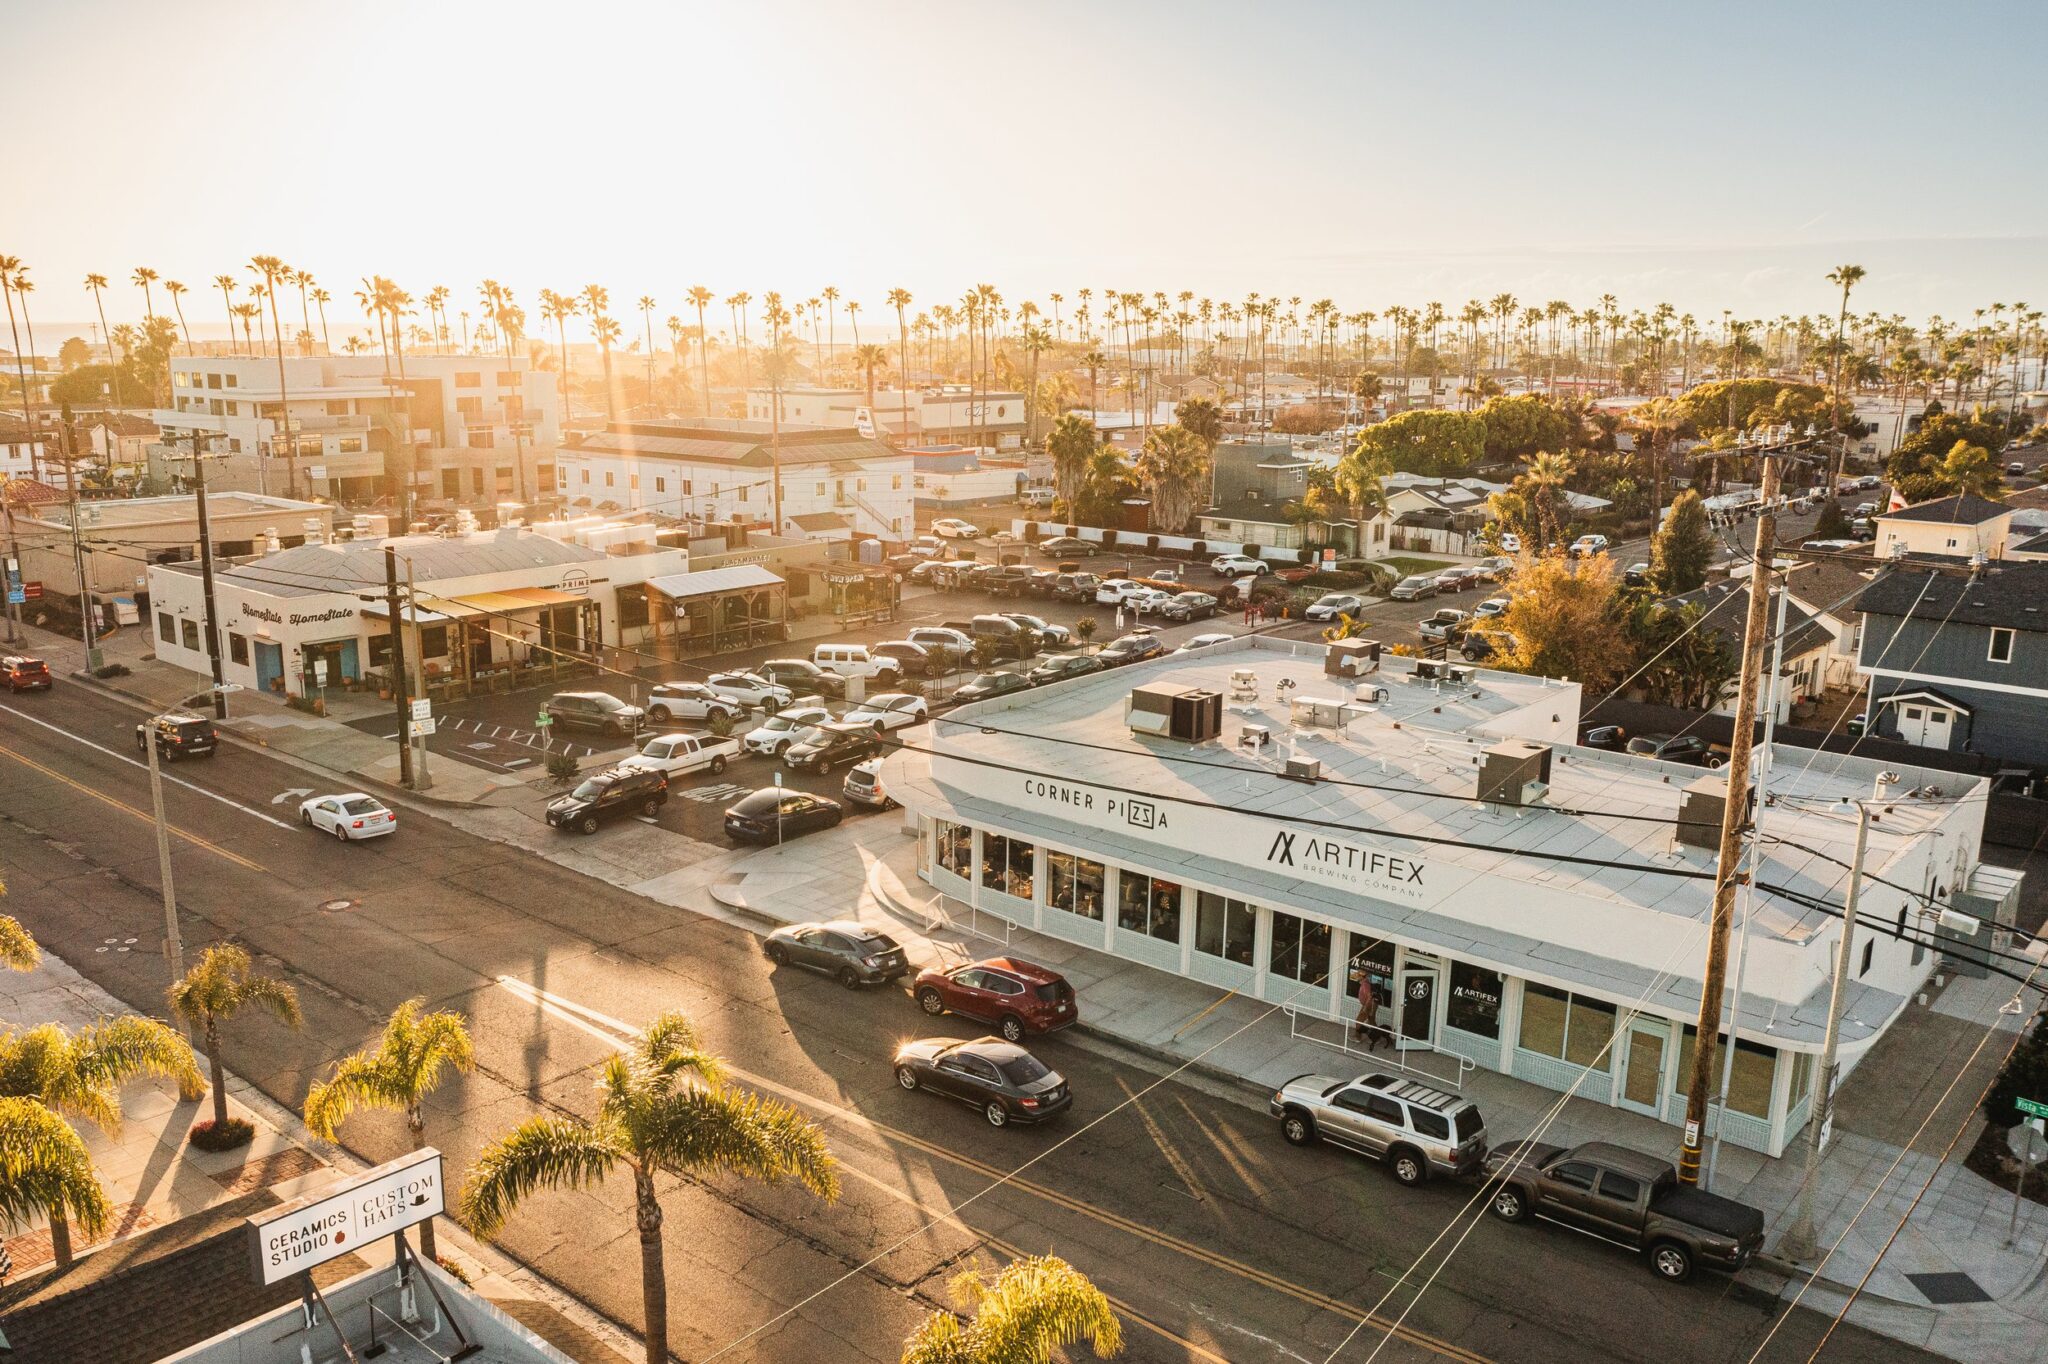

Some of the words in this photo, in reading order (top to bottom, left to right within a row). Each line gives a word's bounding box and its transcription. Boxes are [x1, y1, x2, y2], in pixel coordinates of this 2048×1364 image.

[562, 579, 589, 588] PRIME
[242, 602, 282, 624] HomeState
[289, 607, 353, 626] HomeState
[1025, 779, 1093, 810] CORNER
[1107, 799, 1168, 829] PIZZA
[1304, 837, 1425, 886] ARTIFEX
[1303, 863, 1357, 883] BREWING
[1364, 878, 1424, 898] COMPANY
[1360, 959, 1392, 973] ARTIFEX
[1463, 988, 1498, 1003] ARTIFEX
[2017, 1099, 2036, 1113] Vista
[362, 1175, 433, 1213] CUSTOM
[364, 1201, 406, 1228] HATS
[270, 1211, 347, 1250] CERAMICS
[271, 1233, 328, 1265] STUDIO
